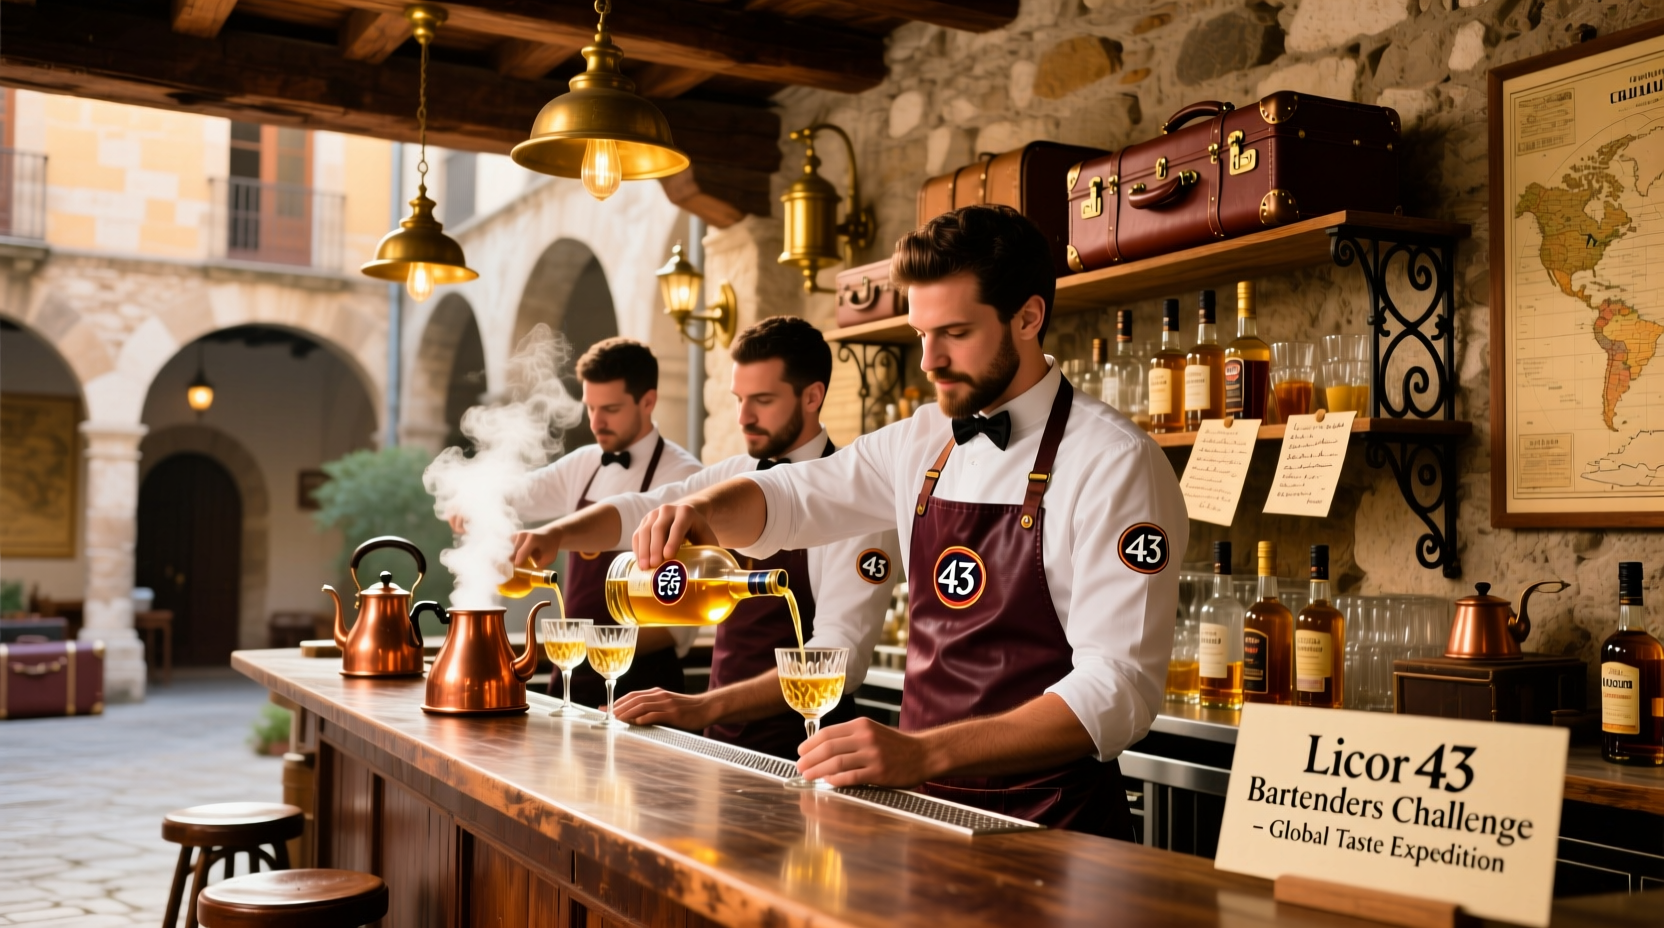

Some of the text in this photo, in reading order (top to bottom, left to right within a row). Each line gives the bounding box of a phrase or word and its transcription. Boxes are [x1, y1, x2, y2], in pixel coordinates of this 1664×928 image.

[862, 556, 886, 577] 43
[1125, 533, 1162, 564] 43
[937, 559, 977, 595] 43
[1303, 734, 1478, 793] Licor 43
[1247, 776, 1534, 847] Bartenders Challenge
[1269, 819, 1329, 847] Global
[1336, 828, 1384, 855] Taste
[1390, 836, 1505, 874] Expedition
